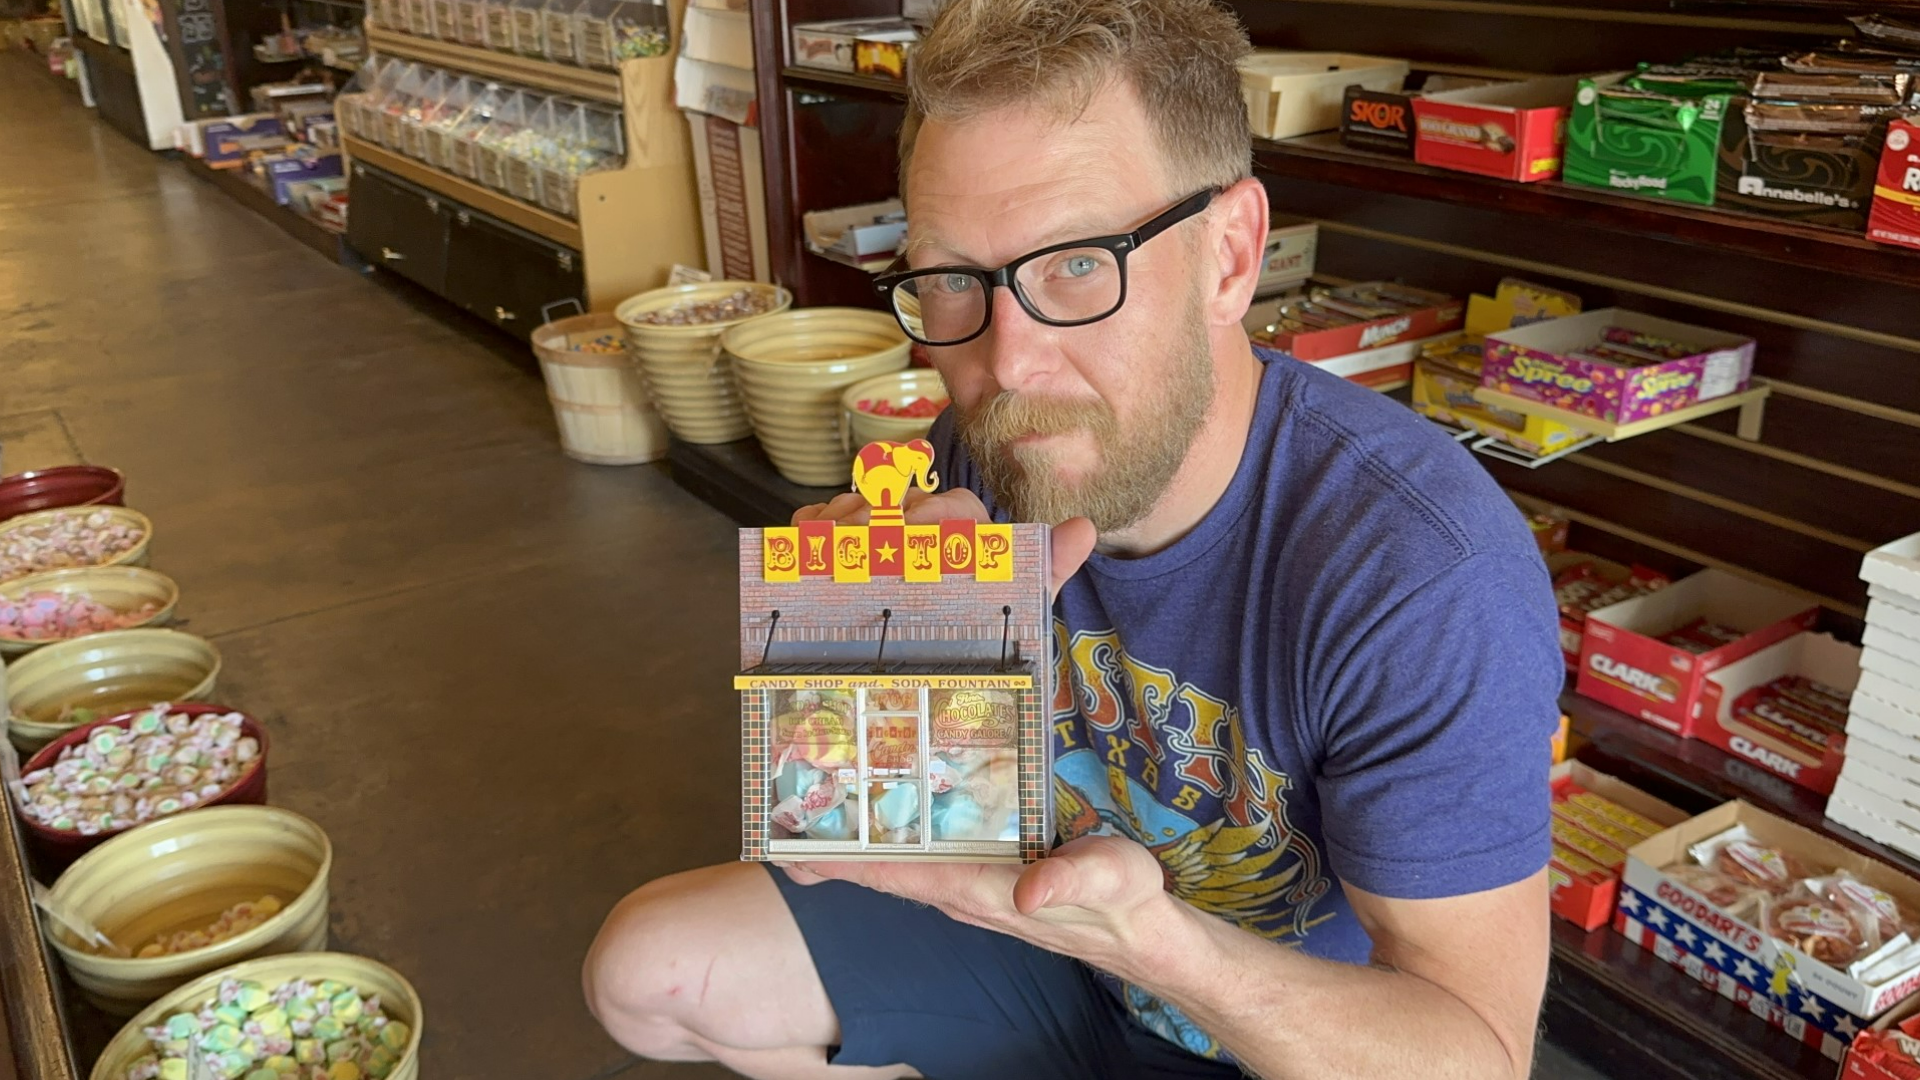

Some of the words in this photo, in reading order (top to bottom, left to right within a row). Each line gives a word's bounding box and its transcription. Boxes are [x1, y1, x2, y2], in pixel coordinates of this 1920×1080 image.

[1351, 100, 1407, 132] SKOR
[1738, 176, 1850, 209] Annabelle's
[1507, 356, 1594, 393] Spree
[1636, 371, 1696, 400] Spree
[766, 534, 867, 572] BIG
[907, 532, 1009, 570] TOP
[749, 679, 798, 689] CANDY
[803, 679, 844, 688] SHOP
[847, 679, 882, 688] and
[891, 679, 932, 688] SODA
[938, 679, 1011, 688] FOUNTAIN
[1590, 652, 1664, 694] CLARK
[934, 698, 1016, 728] CHOCOLATES
[937, 728, 968, 739] CANDY
[1729, 736, 1801, 778] CLARK
[1656, 881, 1763, 954] GOODART'S
